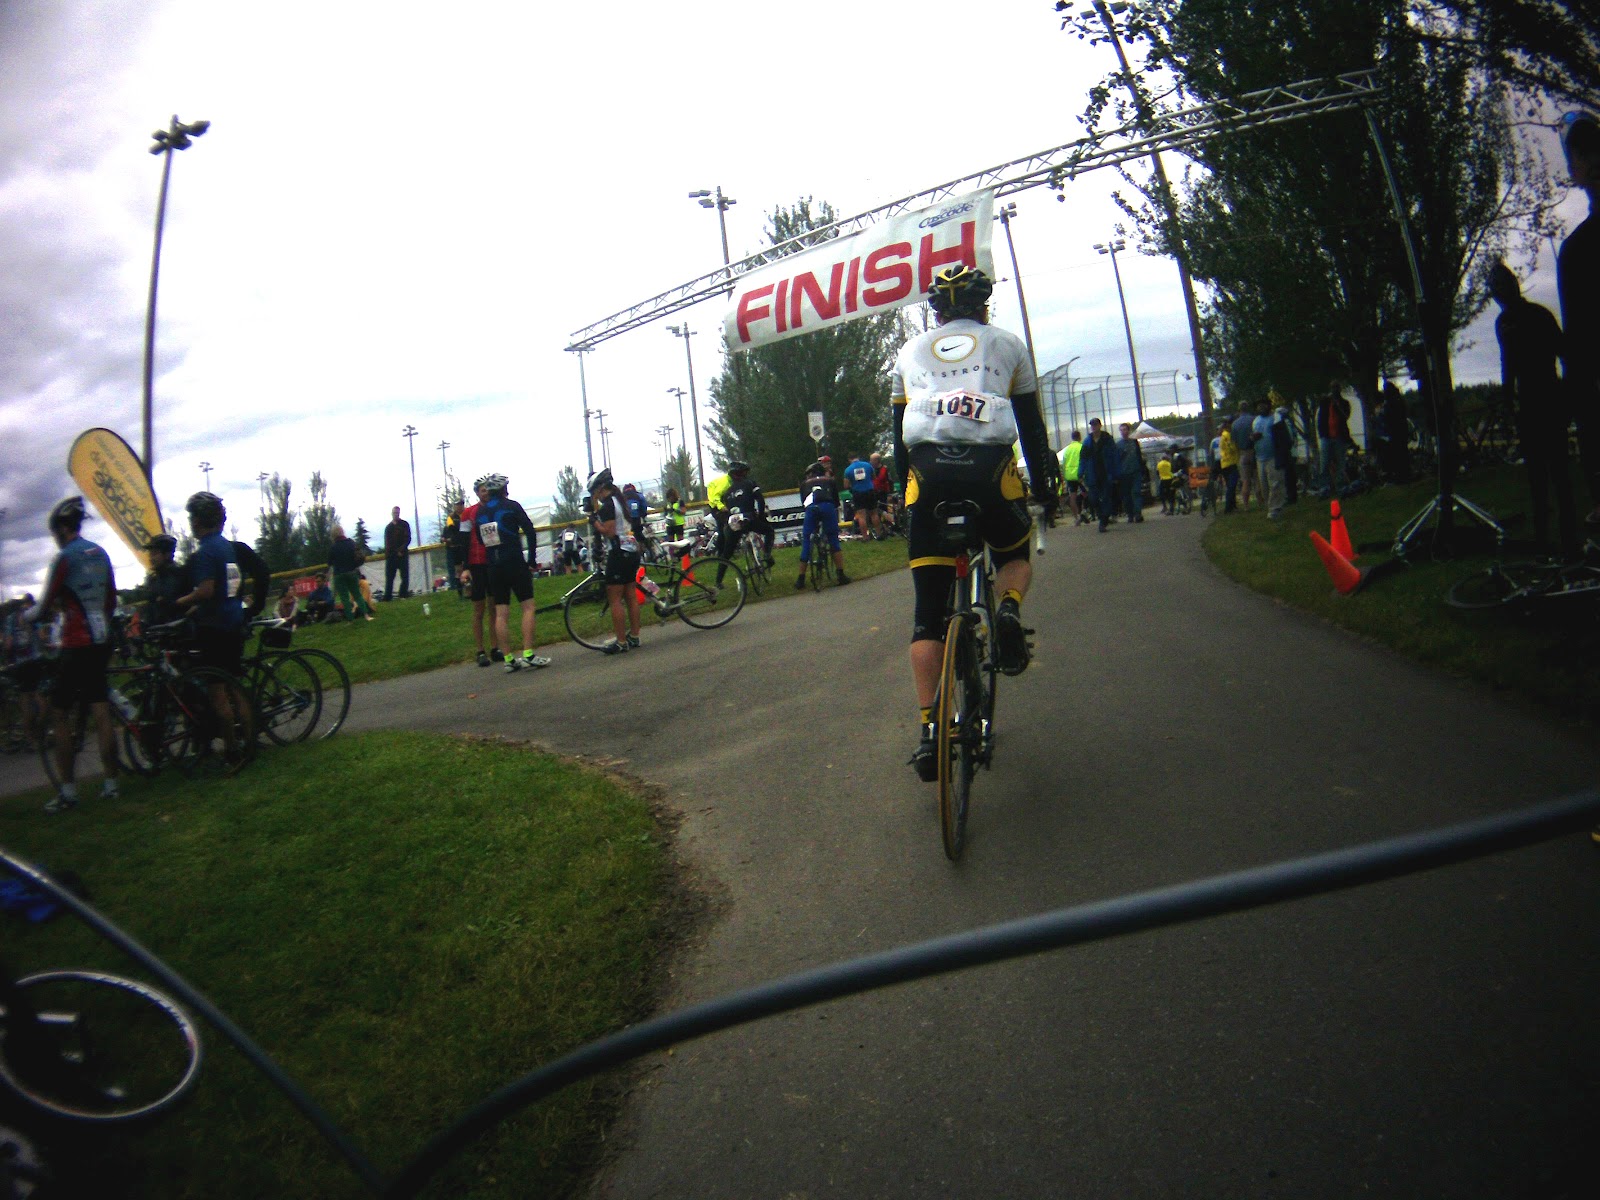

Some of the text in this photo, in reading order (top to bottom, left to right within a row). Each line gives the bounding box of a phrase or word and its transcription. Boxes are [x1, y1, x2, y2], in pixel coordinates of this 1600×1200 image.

[736, 220, 976, 343] FINISH
[911, 365, 1000, 387] LIVESTRONG
[936, 395, 986, 419] 1057
[764, 511, 806, 523] ALEIG
